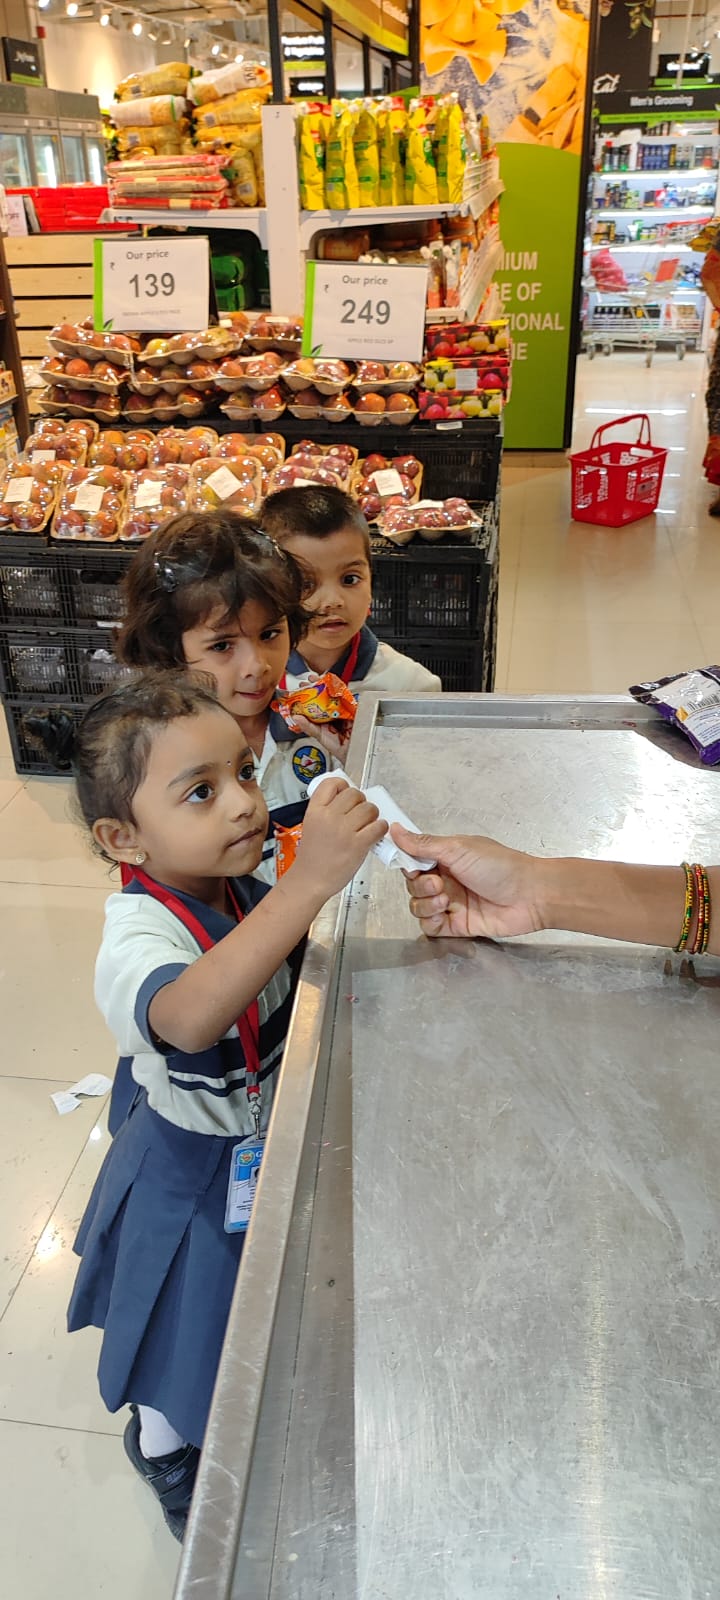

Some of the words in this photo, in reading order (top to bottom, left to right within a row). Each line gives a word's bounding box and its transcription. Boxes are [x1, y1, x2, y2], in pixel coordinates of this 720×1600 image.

[655, 95, 694, 107] Grooming
[126, 251, 144, 260] Our
[146, 250, 169, 260] price
[129, 272, 175, 298] 139
[342, 275, 361, 284] Our
[363, 275, 388, 286] price
[516, 282, 542, 301] OF
[340, 299, 391, 325] 249
